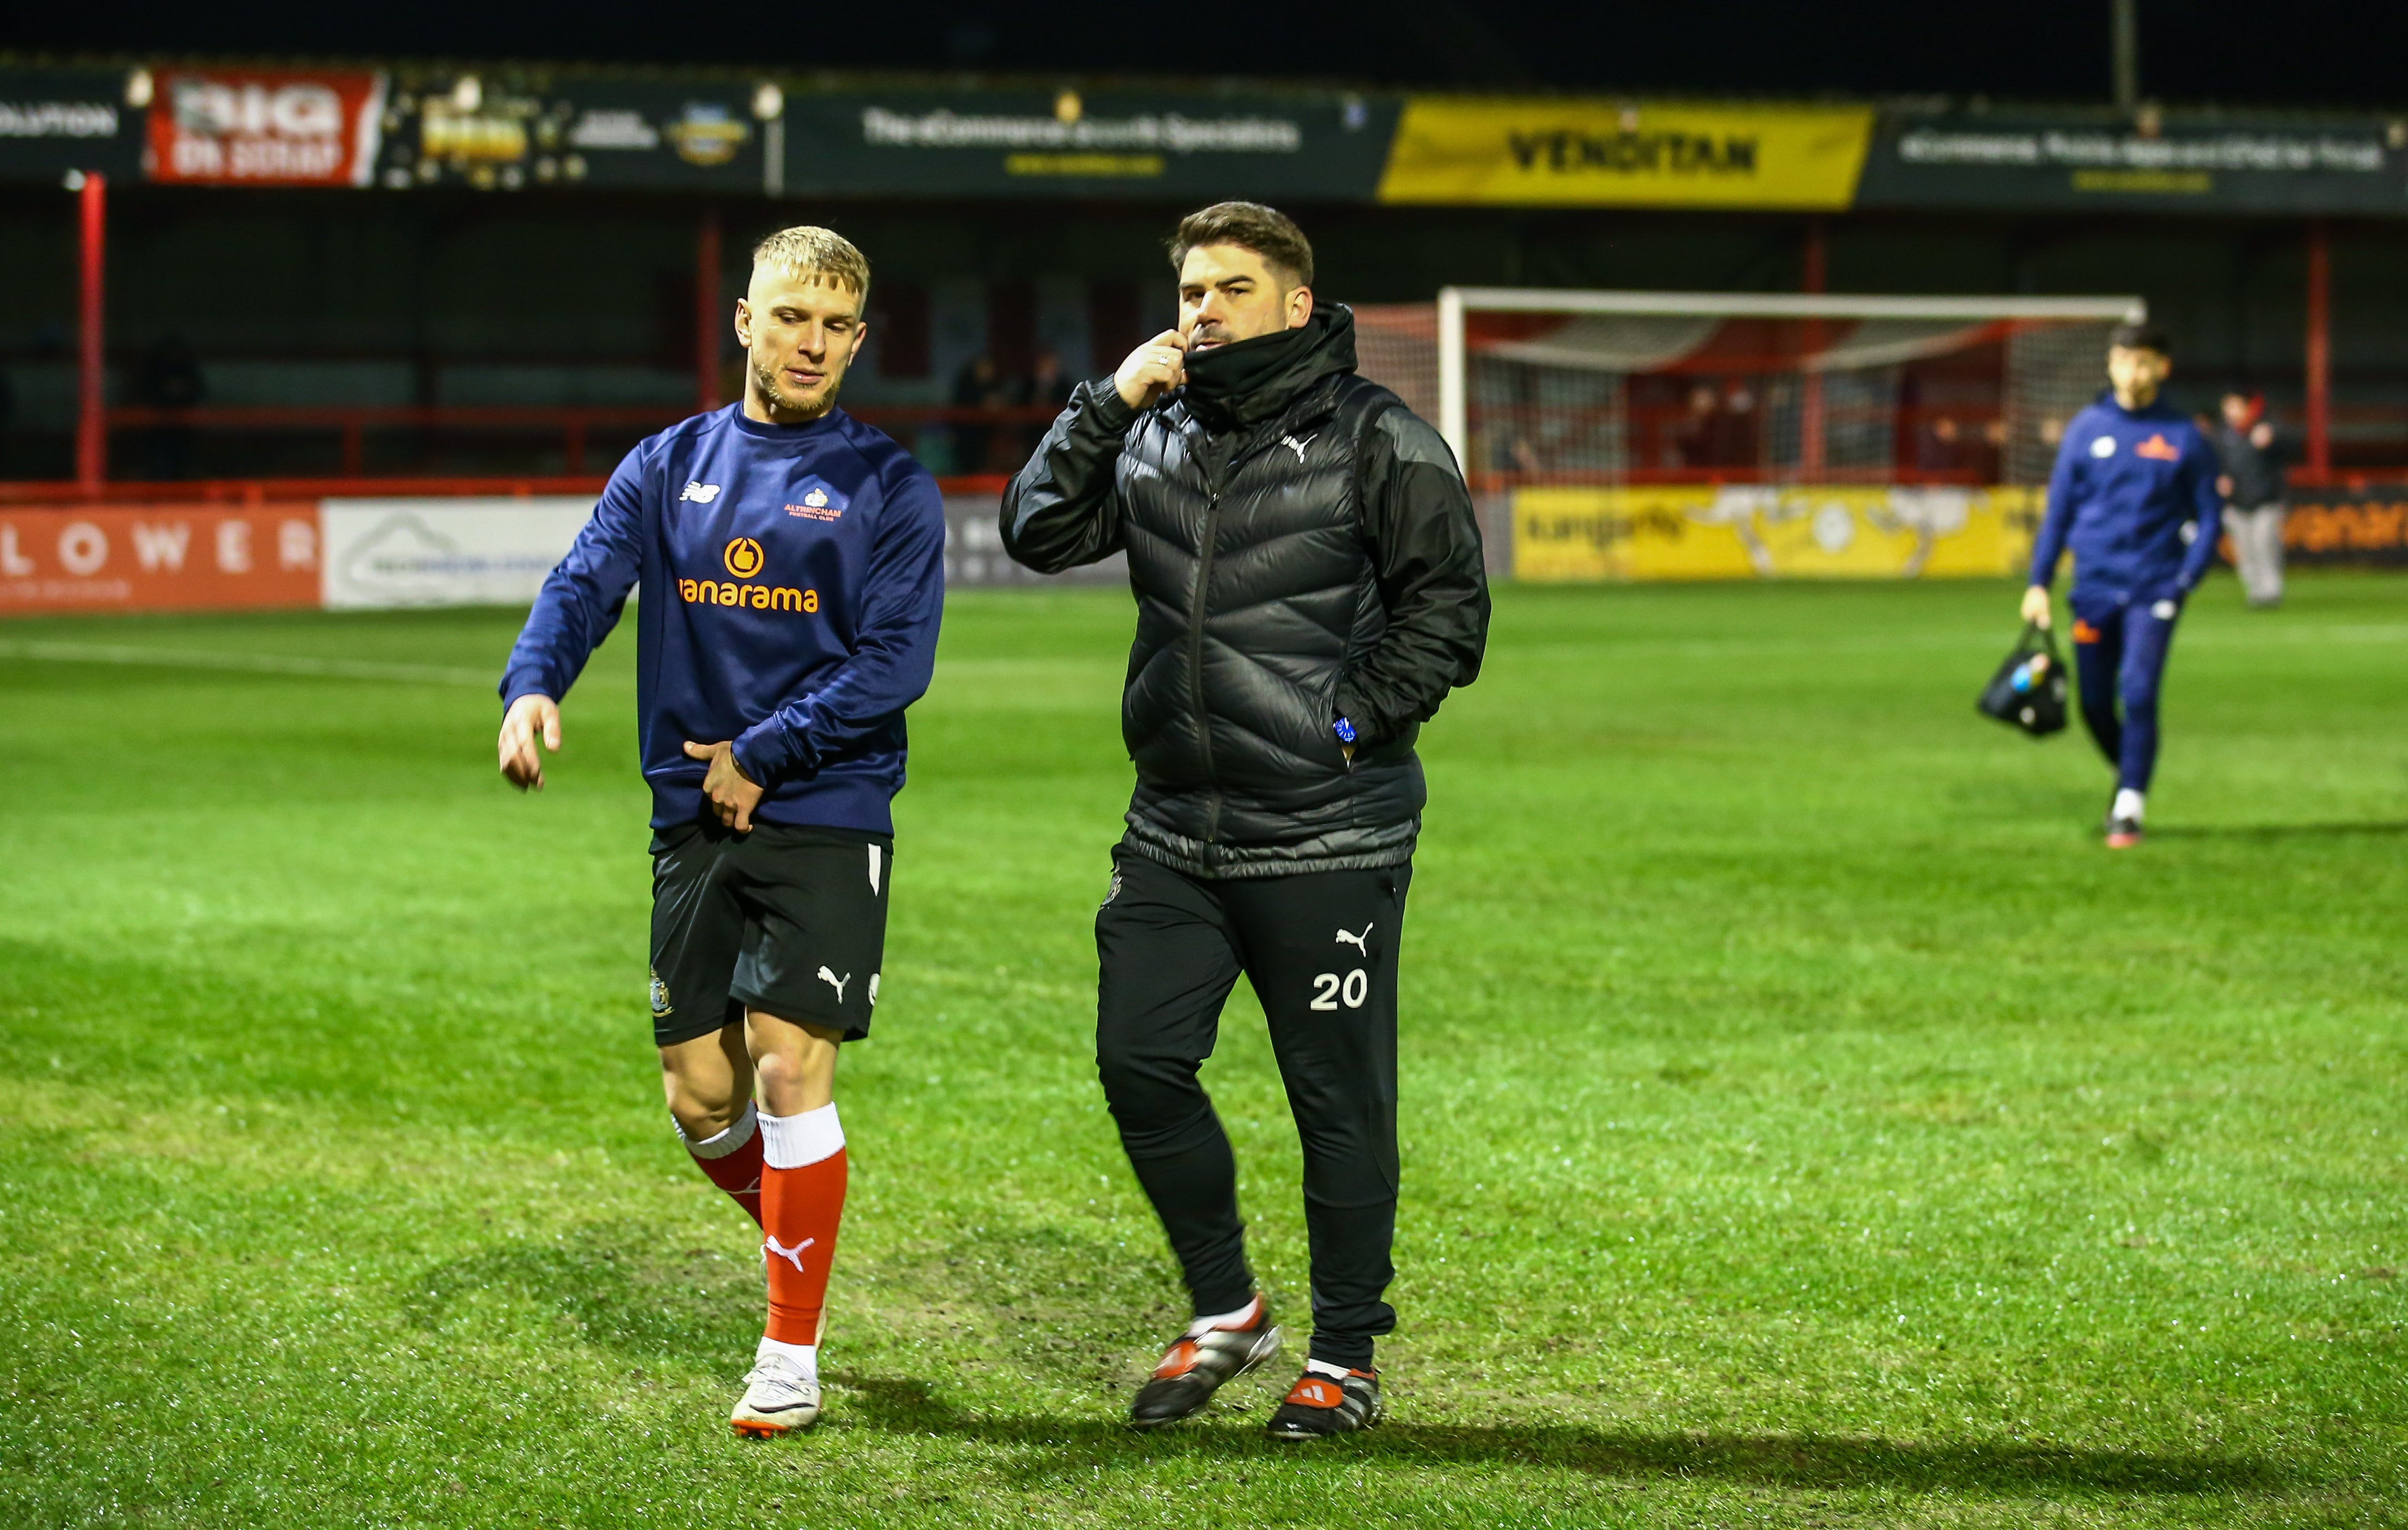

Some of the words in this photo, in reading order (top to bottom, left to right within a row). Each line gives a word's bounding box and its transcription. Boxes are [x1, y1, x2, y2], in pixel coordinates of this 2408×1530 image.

[1507, 131, 1758, 174] VENDITAN
[784, 504, 842, 518] ALTRINCHAM
[789, 511, 818, 520] FOOTBALL
[1310, 968, 1369, 1011] 20
